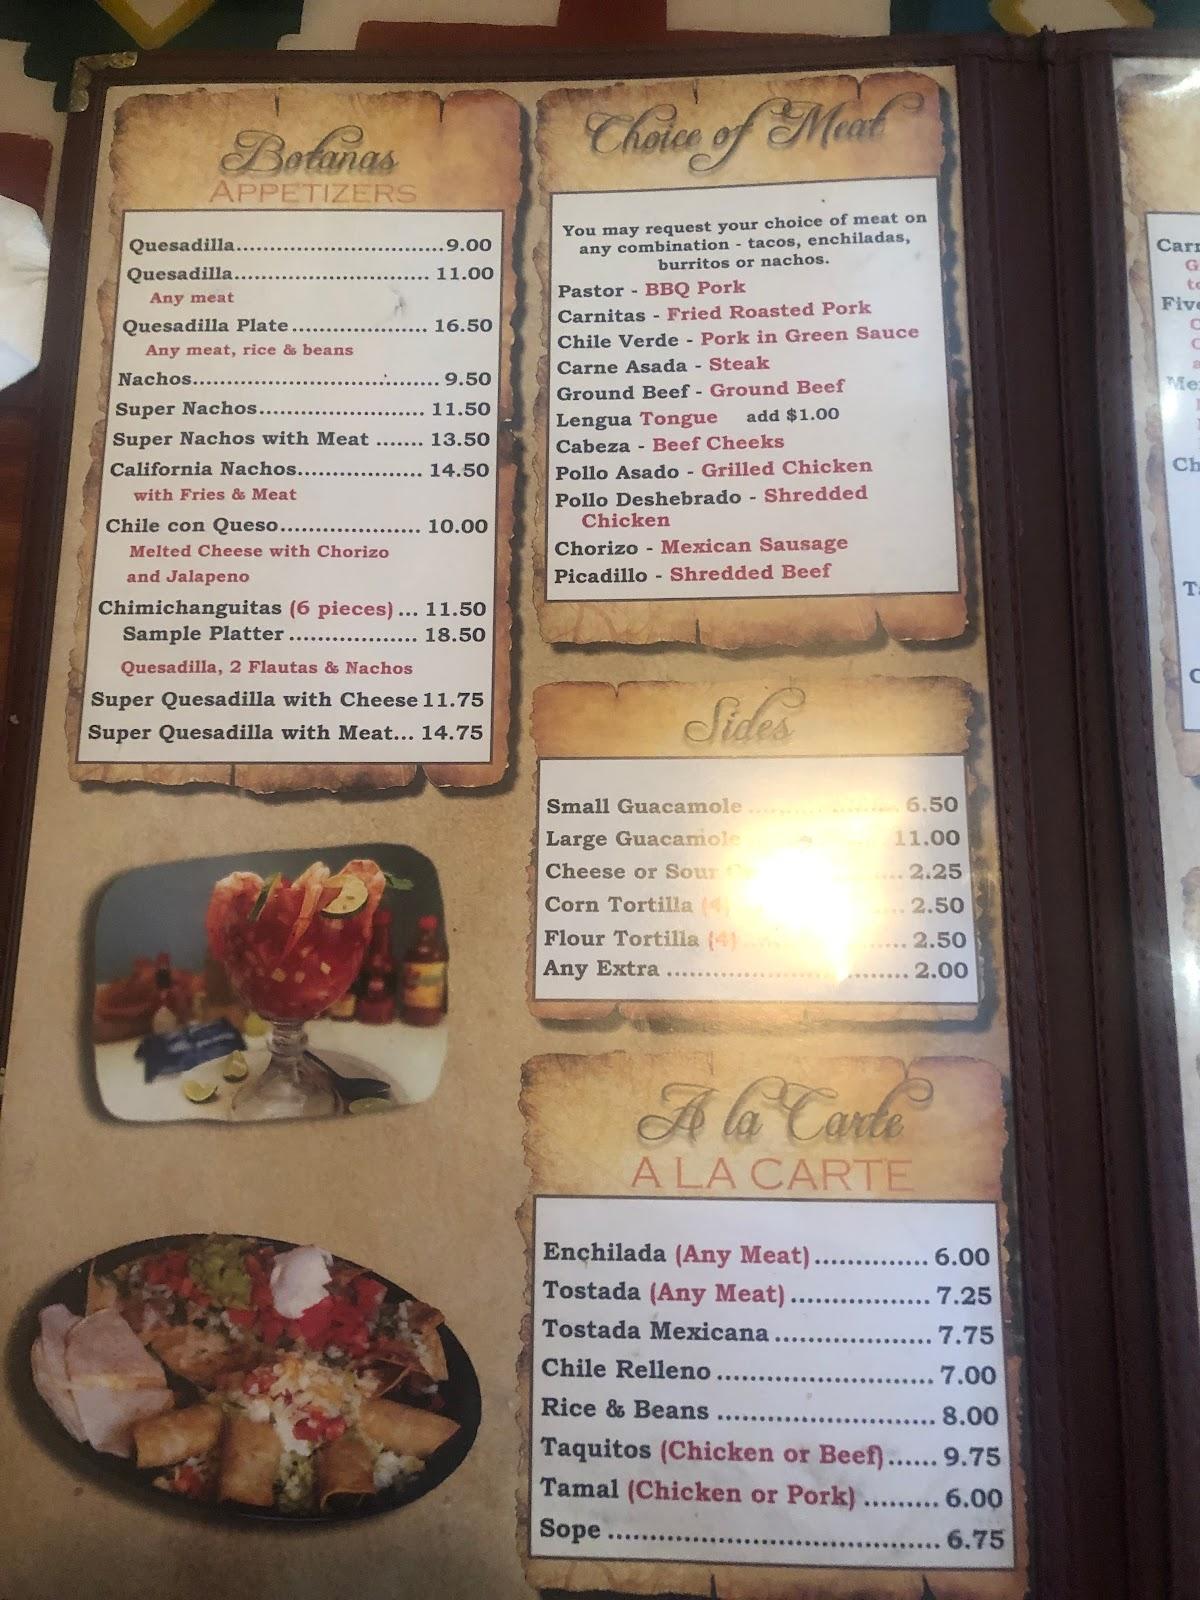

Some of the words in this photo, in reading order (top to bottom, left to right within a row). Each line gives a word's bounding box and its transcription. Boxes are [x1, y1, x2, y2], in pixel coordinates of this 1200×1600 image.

[586, 103, 703, 155] Choice
[769, 91, 925, 149] Meat
[220, 124, 400, 173] Botanas
[209, 180, 417, 204] APPETIZERS
[563, 225, 596, 236] You
[602, 226, 639, 238] may
[646, 221, 712, 236] request
[718, 222, 758, 234] your
[765, 216, 822, 229] choice
[830, 214, 848, 226] of
[853, 213, 898, 225] meat
[905, 215, 927, 223] on
[130, 238, 234, 255] Quesadilla
[447, 239, 491, 251] 9.00
[580, 246, 611, 257] any
[618, 239, 729, 253] combination
[748, 238, 801, 249] tacos,
[808, 231, 910, 246] enchiladas,
[658, 258, 729, 270] burritos
[736, 259, 754, 268] or
[761, 254, 829, 266] nachos.
[150, 292, 184, 306] Any
[190, 292, 234, 303] meat
[558, 285, 624, 298] Pastor
[646, 282, 689, 298] BBQ
[698, 280, 746, 294] Pork
[558, 309, 645, 323] Carnitas
[667, 306, 722, 321] Fried
[730, 302, 814, 319] Roasted
[822, 300, 871, 315] Pork
[123, 319, 229, 336] Quesadilla
[237, 318, 288, 332] Plate
[435, 319, 492, 332] 16.50
[558, 335, 611, 349] Chile
[618, 333, 678, 347] Verde
[701, 331, 749, 345] Pork
[757, 330, 777, 343] in
[785, 329, 848, 342] Green
[857, 327, 918, 340] Sauce
[145, 345, 180, 359] Any
[186, 345, 236, 358] meat,
[243, 344, 276, 355] rice
[283, 344, 296, 355] &
[303, 344, 353, 355] beans
[557, 361, 617, 374] Carne
[625, 359, 687, 373] Asada
[710, 356, 770, 371] Steak
[118, 372, 191, 386] Nachos
[445, 372, 491, 386] 9.50
[557, 386, 634, 401] Ground
[643, 384, 690, 399] Beef
[710, 381, 789, 397] Ground
[797, 379, 845, 394] Beef
[556, 414, 632, 430] Lengua
[640, 412, 717, 428] Tongue
[747, 409, 779, 422] add
[787, 408, 839, 423] $1.00
[113, 433, 173, 449] Super
[180, 431, 254, 445] Nachos
[262, 431, 309, 445] with
[317, 432, 368, 446] Meat
[432, 432, 490, 446] 13.50
[110, 462, 212, 477] California
[220, 461, 296, 475] Nachos
[431, 463, 489, 477] 14.50
[556, 466, 608, 480] Pollo
[616, 464, 679, 479] Asado
[702, 461, 774, 477] Grilled
[783, 459, 872, 475] Chicken
[134, 489, 173, 501] with
[180, 488, 225, 500] Fries
[232, 488, 245, 500] &
[252, 488, 296, 500] Meat
[555, 493, 608, 507] Pollo
[616, 490, 741, 506] Deshebrado
[765, 485, 868, 503] Shredded
[106, 518, 159, 533] Chile
[168, 522, 205, 532] con
[213, 518, 278, 535] Queso
[429, 519, 488, 533] 10.00
[582, 513, 670, 528] Chicken
[129, 545, 191, 557] Melted
[198, 544, 262, 557] Cheese
[270, 545, 310, 557] with
[317, 545, 389, 558] Chorizo
[555, 568, 647, 583] Picadillo
[671, 565, 774, 581] Shredded
[782, 563, 832, 579] Beef
[98, 600, 281, 618] Chimichanguitas
[290, 600, 309, 619] (6
[318, 601, 392, 620] pieces)
[427, 602, 486, 616] 11.50
[123, 626, 201, 645] Sample
[209, 626, 284, 640] Platter
[426, 628, 485, 642] 18.50
[121, 660, 222, 677] Quesadilla,
[230, 660, 241, 673] 2
[248, 660, 317, 673] Flautas
[325, 661, 339, 674] &
[346, 662, 412, 674] Nachos
[91, 692, 154, 711] Super
[162, 691, 275, 710] Quesadilla
[283, 692, 332, 706] with
[341, 692, 417, 707] Cheese
[424, 692, 483, 707] 11.75
[684, 686, 806, 743] Sides
[546, 798, 610, 814] Small
[617, 798, 743, 814] Guacamole
[905, 797, 959, 813] 6.50
[544, 863, 626, 880] Cheese
[633, 866, 658, 880] or
[664, 863, 718, 880] Sour
[909, 864, 963, 880] 2.25
[543, 930, 606, 947] Flour
[612, 930, 700, 947] Tortilla
[912, 932, 967, 949] 2.50
[542, 960, 591, 979] Any
[597, 960, 661, 977] Extra
[914, 962, 969, 979] 2.00
[637, 1083, 719, 1142] A
[764, 1075, 935, 1142] Carte
[631, 1156, 662, 1188] A
[675, 1156, 737, 1189] LA
[750, 1158, 915, 1193] CARTE
[544, 1242, 666, 1264] Enchilada
[676, 1244, 731, 1268] (Any
[740, 1245, 809, 1269] Meat)
[935, 1248, 990, 1266] 6.00
[543, 1280, 641, 1300] Tostada
[651, 1282, 706, 1307] (Any
[715, 1284, 784, 1308] Meat)
[937, 1287, 992, 1305] 7.25
[542, 1397, 596, 1417] Rice
[606, 1399, 625, 1418] &
[634, 1400, 709, 1420] Beans
[943, 1406, 998, 1425] 8.00
[540, 1437, 651, 1463] Taquitos
[661, 1440, 774, 1464] (Chicken
[784, 1448, 810, 1463] or
[819, 1445, 883, 1470] Beef)
[944, 1447, 1001, 1466] 9.75
[540, 1477, 619, 1498] Tamal
[628, 1480, 741, 1504] (Chicken
[751, 1489, 778, 1504] or
[787, 1485, 855, 1511] Pork)
[946, 1488, 1003, 1510] 6.00
[540, 1518, 600, 1544] Sope
[947, 1529, 1005, 1550] 6.75
